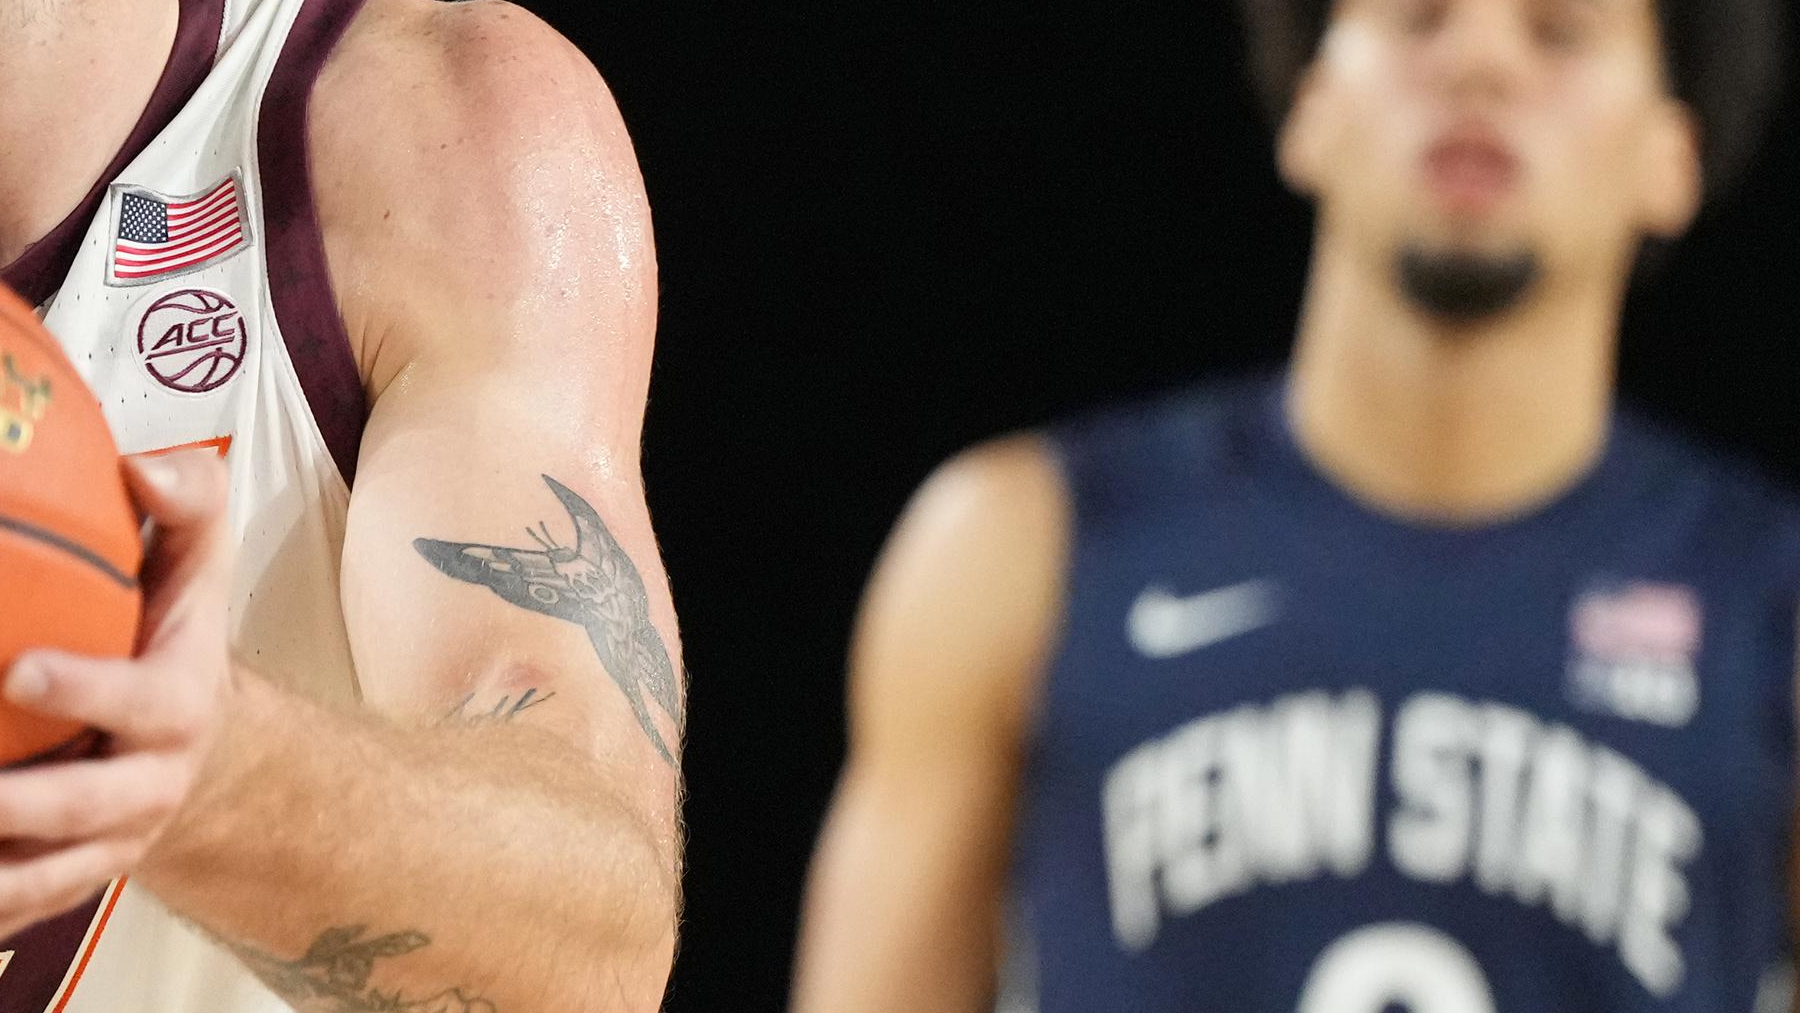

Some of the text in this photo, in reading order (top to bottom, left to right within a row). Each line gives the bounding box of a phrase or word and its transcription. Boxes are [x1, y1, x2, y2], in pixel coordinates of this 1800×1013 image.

[151, 310, 238, 351] ACC
[1102, 686, 1703, 998] PENN STATE
